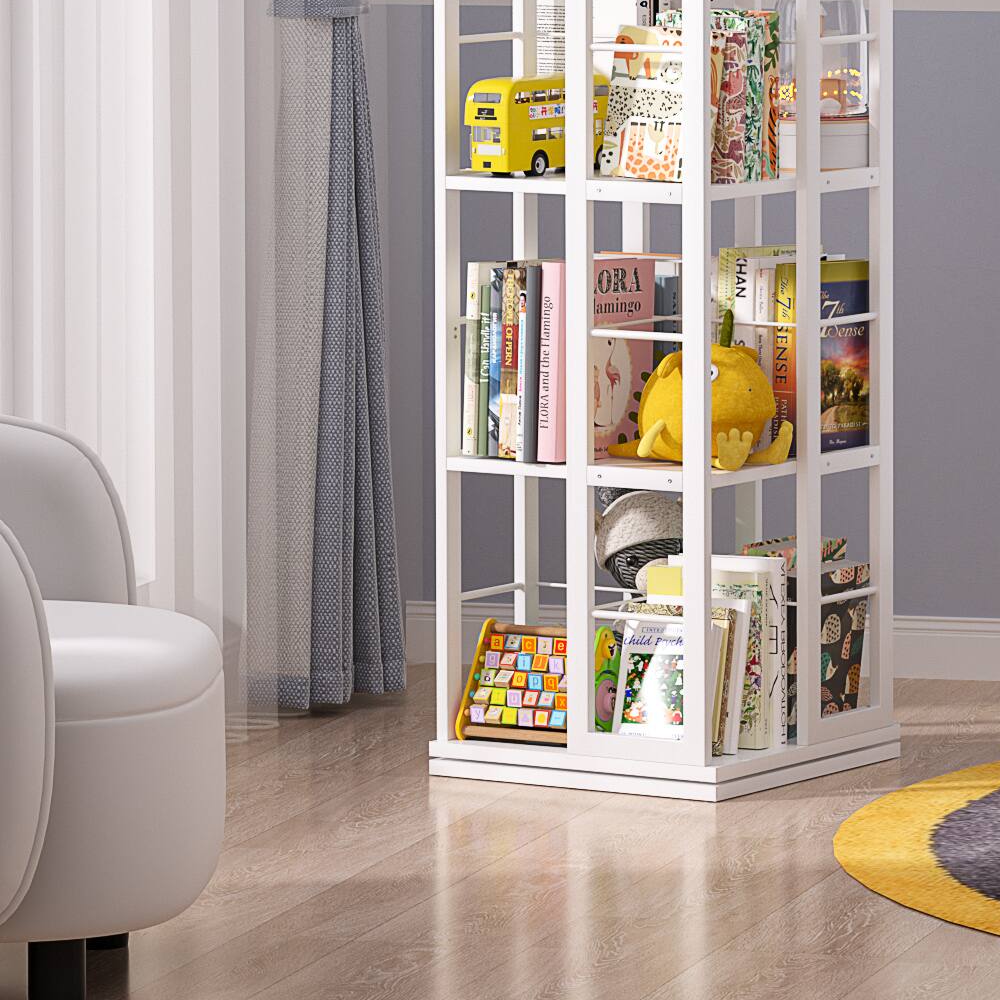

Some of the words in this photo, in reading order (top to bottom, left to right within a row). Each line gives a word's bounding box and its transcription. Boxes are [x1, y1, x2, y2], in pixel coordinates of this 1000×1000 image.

[594, 267, 642, 294] ORA
[780, 278, 789, 295] The
[594, 297, 642, 317] lamingo
[776, 297, 792, 318] 7th
[541, 296, 553, 348] Flamingo
[827, 322, 865, 337] Sense
[505, 328, 513, 341] OF
[505, 341, 513, 366] PERN
[540, 349, 550, 368] the
[776, 325, 789, 384] SENSE
[540, 370, 549, 392] and
[539, 394, 549, 429] FLORA
[525, 641, 532, 649] c
[532, 676, 539, 686] p
[548, 678, 555, 687] q
